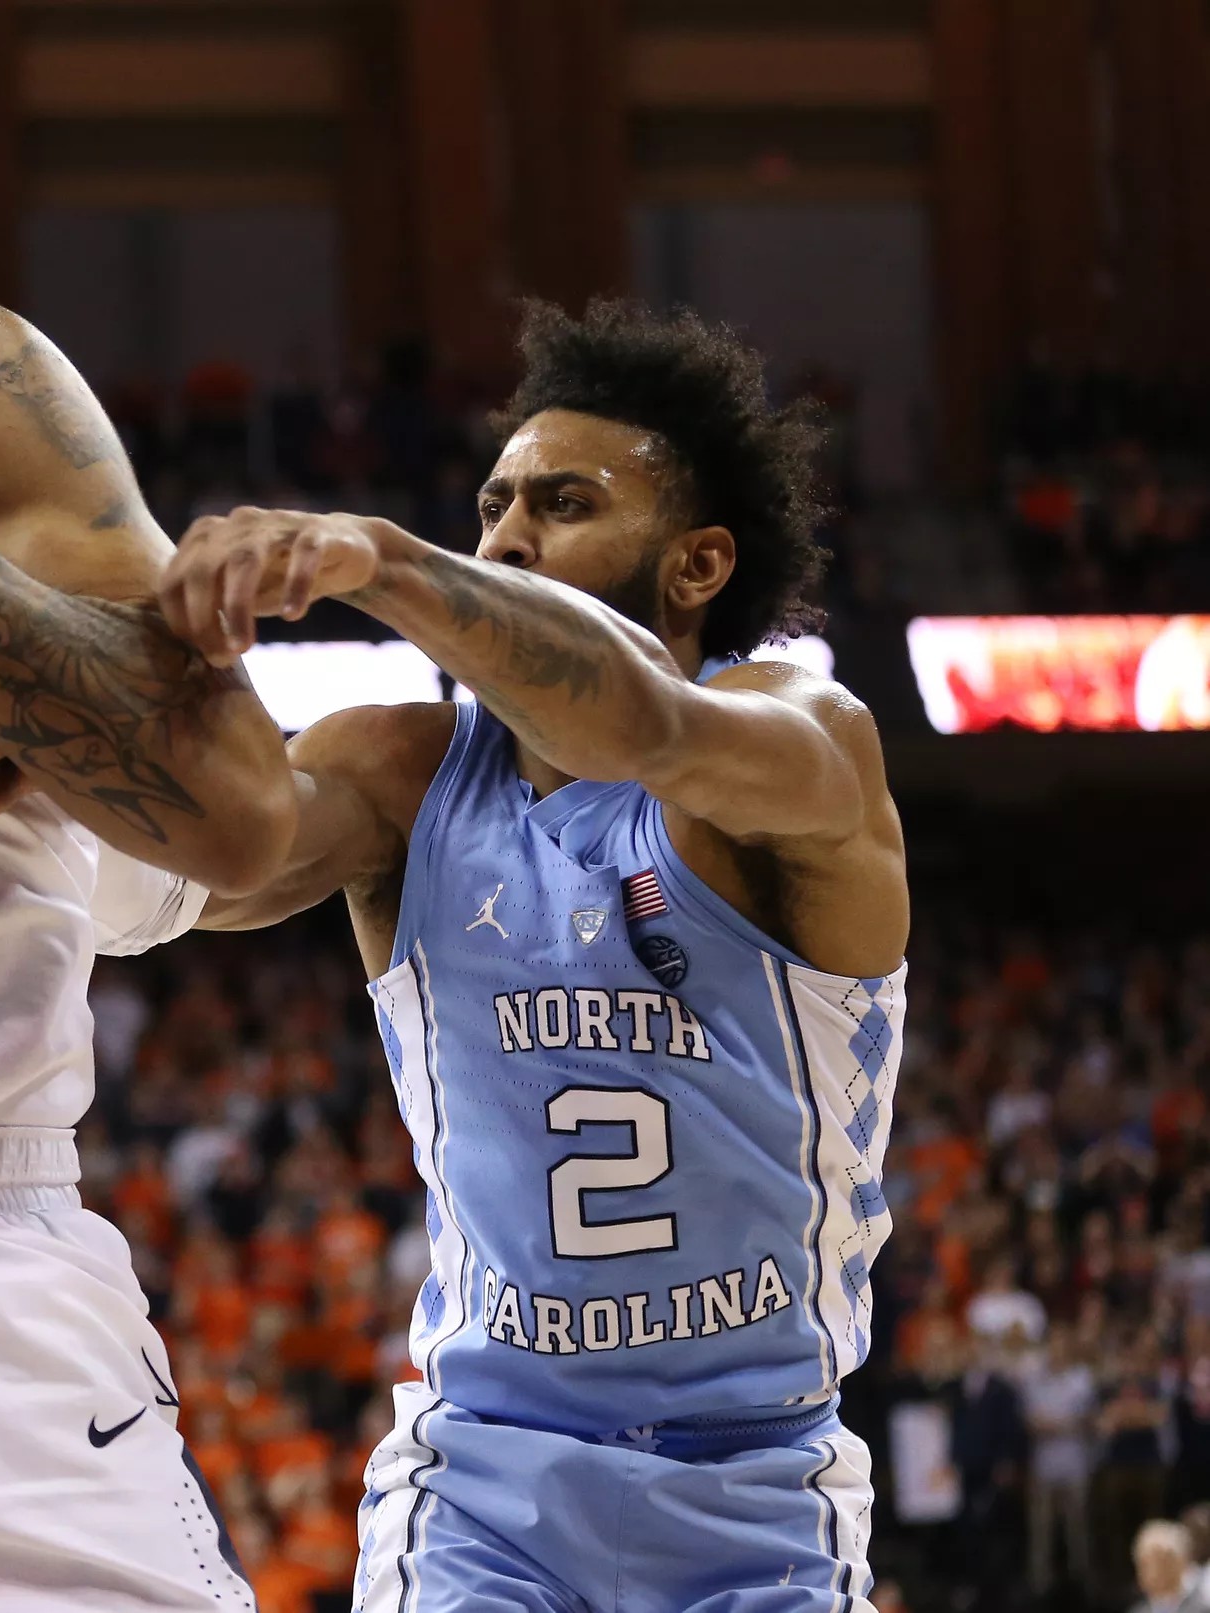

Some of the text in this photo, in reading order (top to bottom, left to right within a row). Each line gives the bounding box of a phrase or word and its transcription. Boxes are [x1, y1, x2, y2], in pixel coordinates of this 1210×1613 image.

[494, 986, 712, 1063] NORTH
[545, 1085, 678, 1260] 2
[481, 1254, 792, 1356] CAROLINA
